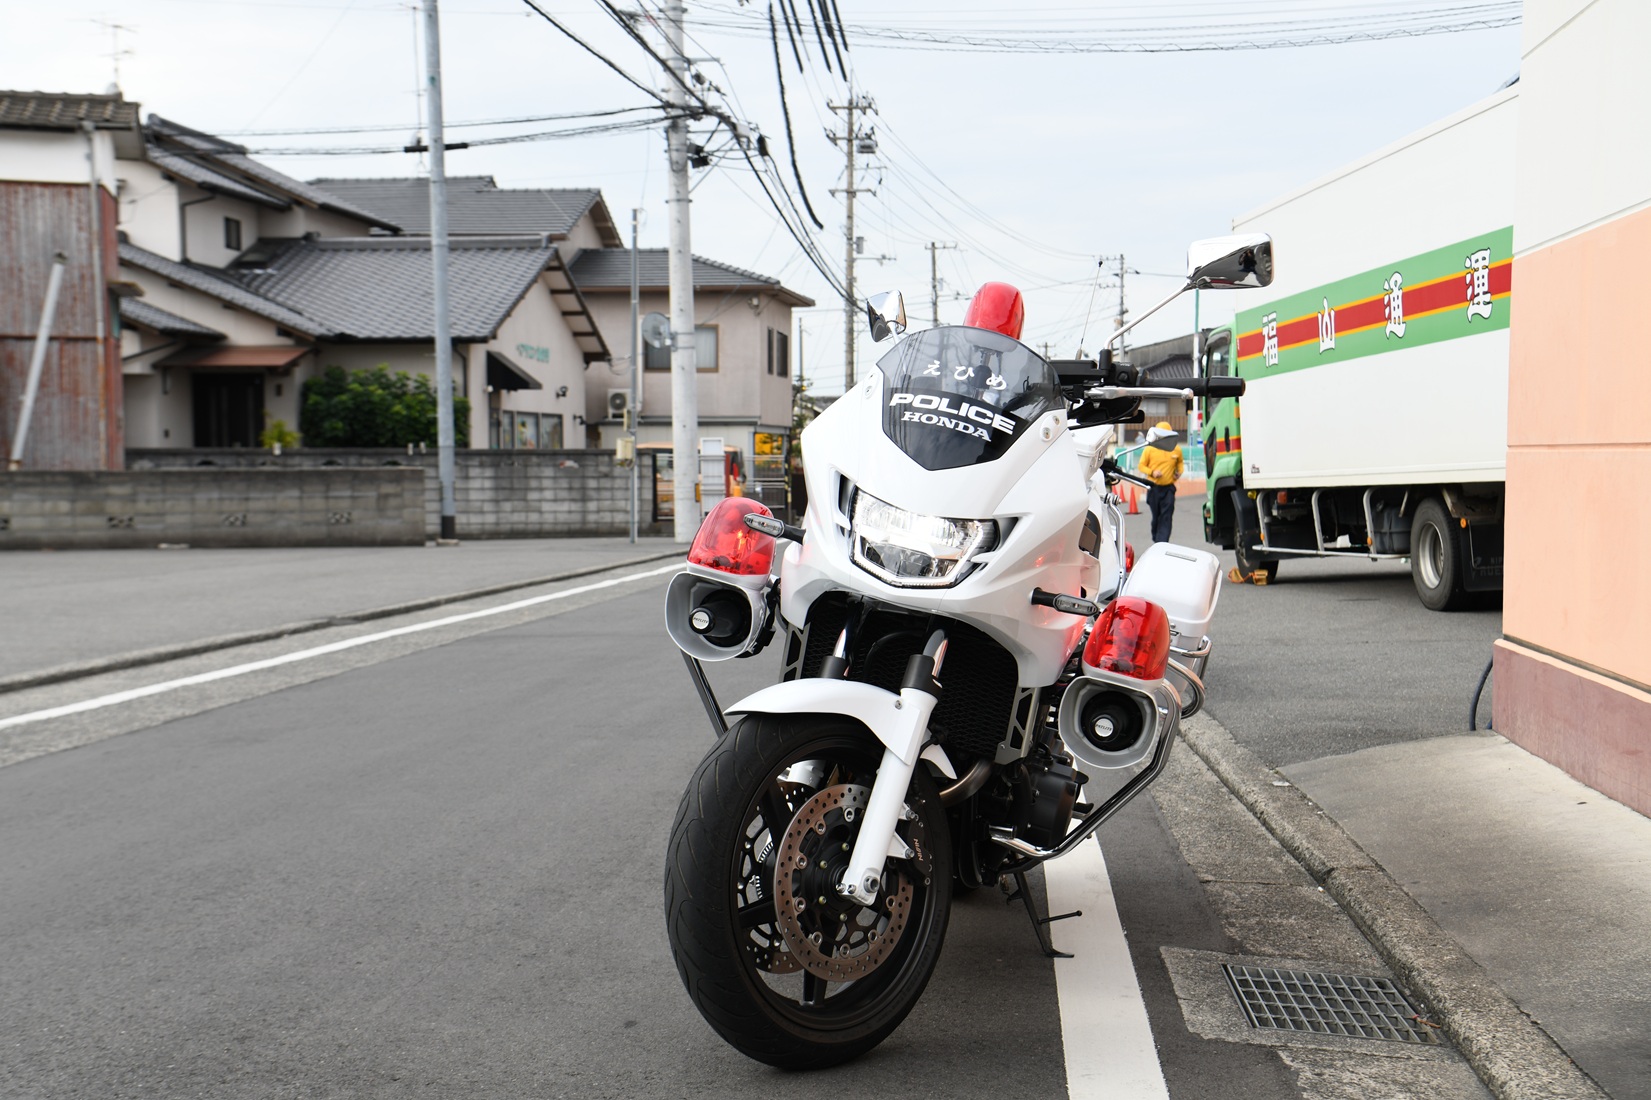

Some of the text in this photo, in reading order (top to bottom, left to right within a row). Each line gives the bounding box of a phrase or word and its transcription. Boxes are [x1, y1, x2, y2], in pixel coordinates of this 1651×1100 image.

[1262, 247, 1494, 369] 福山通運
[922, 360, 1008, 391] えひめ
[889, 393, 1017, 435] POLICE
[901, 411, 992, 442] HONDA
